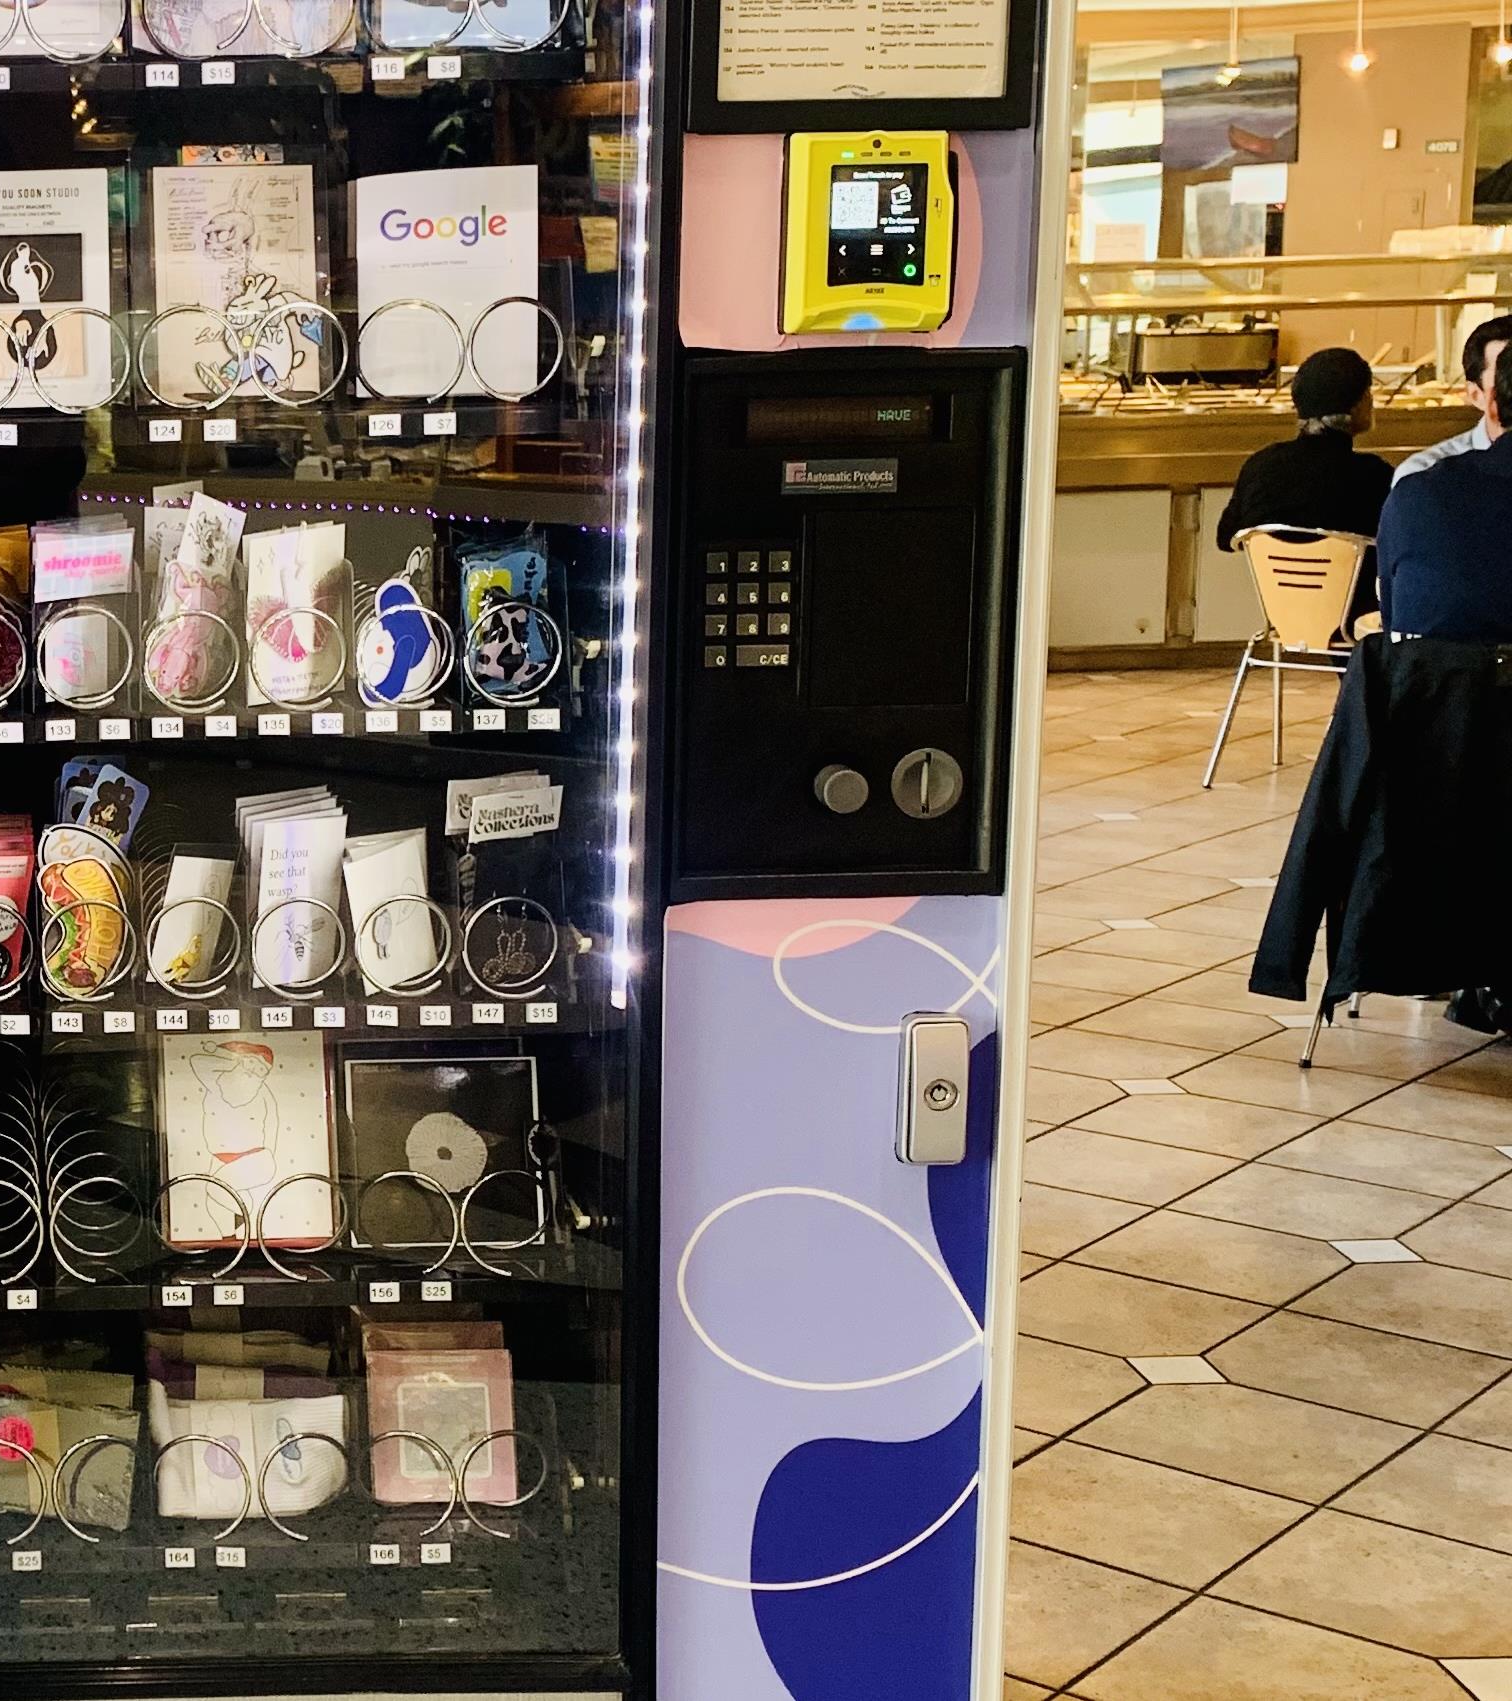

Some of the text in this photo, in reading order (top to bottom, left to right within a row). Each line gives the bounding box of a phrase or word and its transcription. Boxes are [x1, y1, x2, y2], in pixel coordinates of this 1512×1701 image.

[209, 67, 232, 79] $15
[375, 63, 398, 74] 116
[440, 62, 456, 73] $8
[153, 70, 174, 81] 114
[18, 189, 41, 198] SOON
[46, 188, 79, 198] STUDIO
[380, 205, 507, 246] Google
[877, 410, 911, 421] HAVE
[372, 419, 394, 430] 126
[437, 418, 452, 430] $7
[154, 426, 176, 436] 124
[807, 470, 893, 482] Automatic Products
[43, 551, 122, 571] shroomie
[750, 561, 758, 572] 2
[782, 561, 789, 571] 3
[720, 562, 725, 572] 1
[717, 593, 726, 603] 4
[749, 592, 757, 603] 5
[781, 592, 788, 602] 6
[717, 625, 725, 634] 7
[748, 624, 757, 634] 8
[780, 624, 788, 633] 9
[759, 655, 788, 665] C/CE
[264, 719, 285, 730] 135
[431, 716, 446, 727] $5
[476, 714, 498, 725] 137
[50, 725, 71, 736] 133
[105, 724, 120, 735] $6
[159, 723, 179, 733] 134
[216, 720, 229, 731] $4
[474, 813, 554, 835] Collections
[271, 848, 308, 860] Did you
[268, 866, 306, 878] see that
[268, 884, 298, 898] wasp?
[266, 1012, 288, 1022] 145
[322, 1012, 336, 1023] $3
[371, 1009, 392, 1019] 146
[424, 1010, 447, 1021] $10
[478, 1008, 499, 1018] 147
[532, 1007, 554, 1018] $15
[58, 1018, 79, 1028] 143
[113, 1017, 128, 1028] $8
[163, 1015, 183, 1024] 144
[208, 1015, 229, 1024] $10
[2, 1020, 16, 1031] $2
[166, 1291, 186, 1301] 154
[224, 1290, 237, 1300] $6
[371, 1288, 393, 1298] 156
[425, 1286, 447, 1297] $25
[16, 1294, 30, 1305] $4
[169, 1552, 189, 1562] 164
[374, 1549, 394, 1559] 166
[427, 1548, 441, 1559] $5
[17, 1556, 39, 1567] $25
